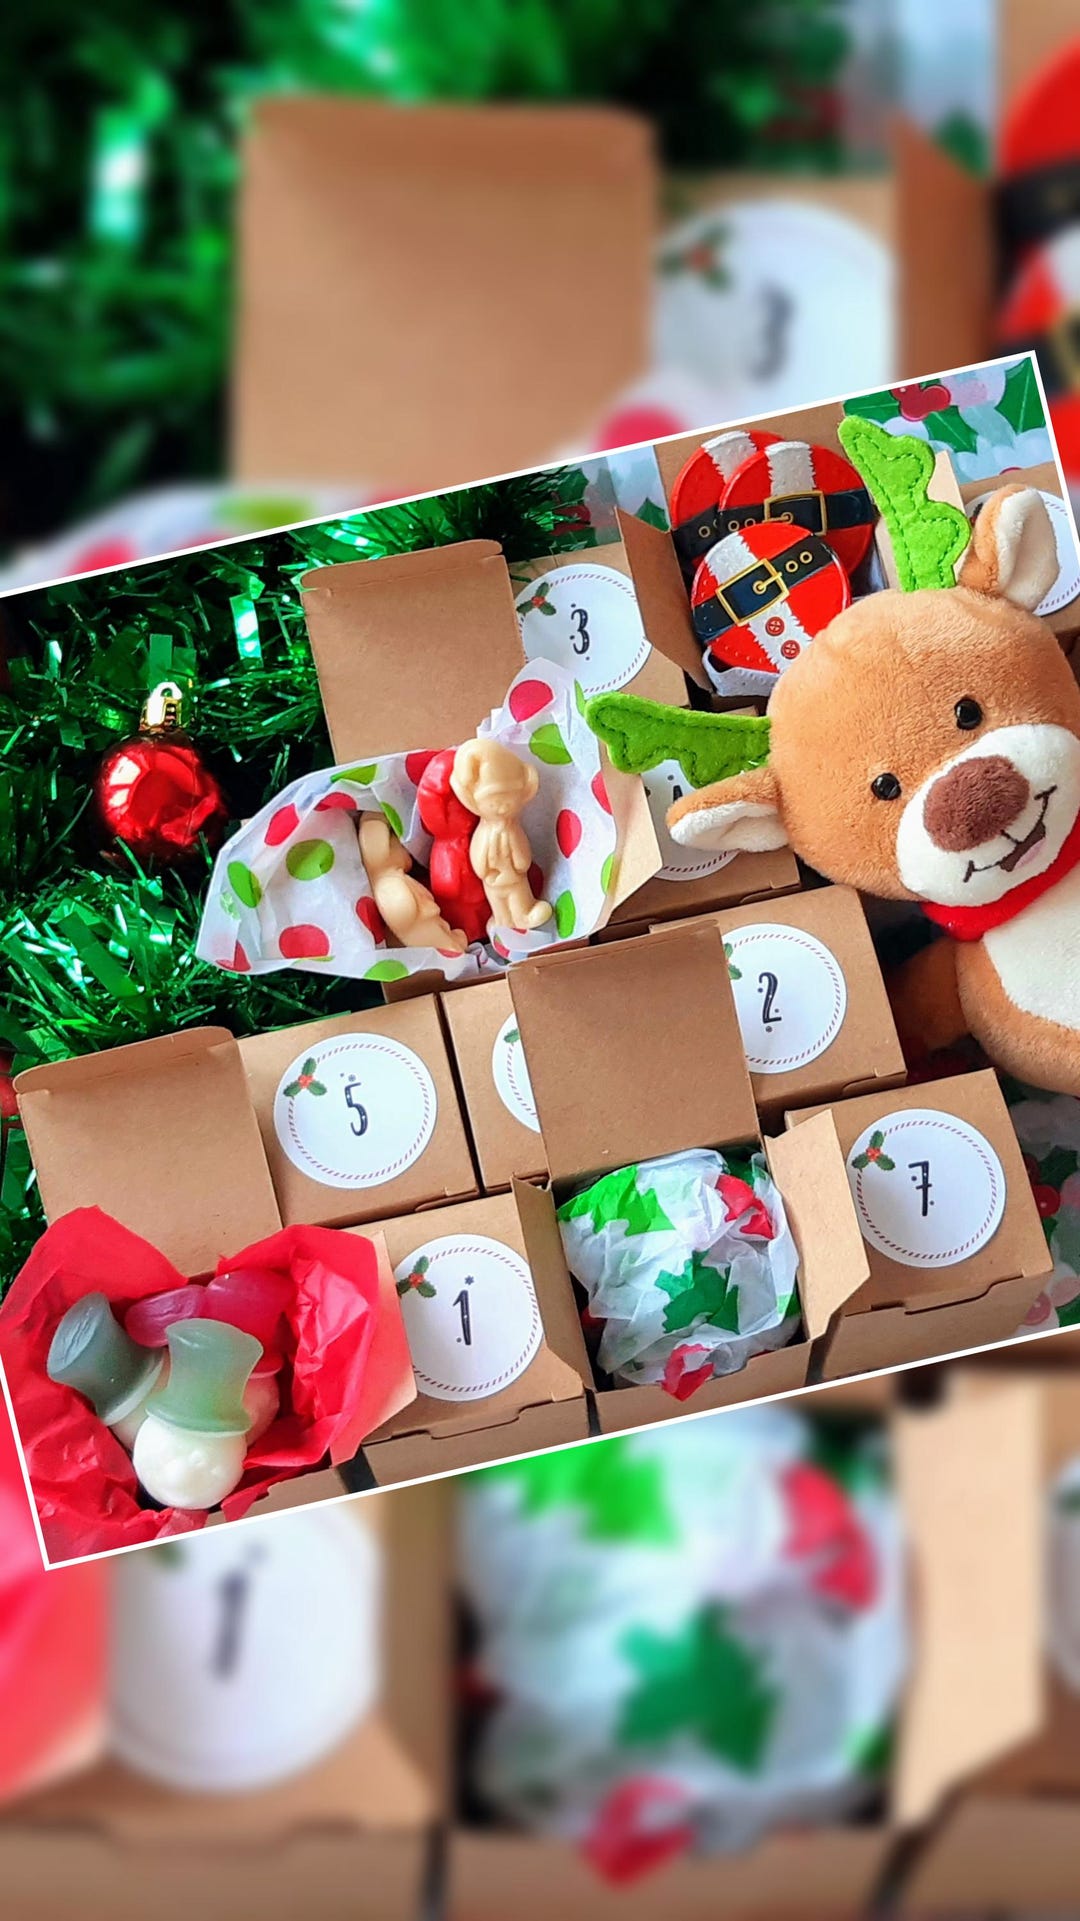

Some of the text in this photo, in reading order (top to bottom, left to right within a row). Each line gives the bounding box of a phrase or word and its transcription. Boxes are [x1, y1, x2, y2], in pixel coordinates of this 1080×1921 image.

[570, 610, 590, 655] 3
[758, 972, 782, 1024] 2
[344, 1083, 369, 1137] 5
[908, 1161, 932, 1216] 7
[453, 1290, 474, 1345] 1
